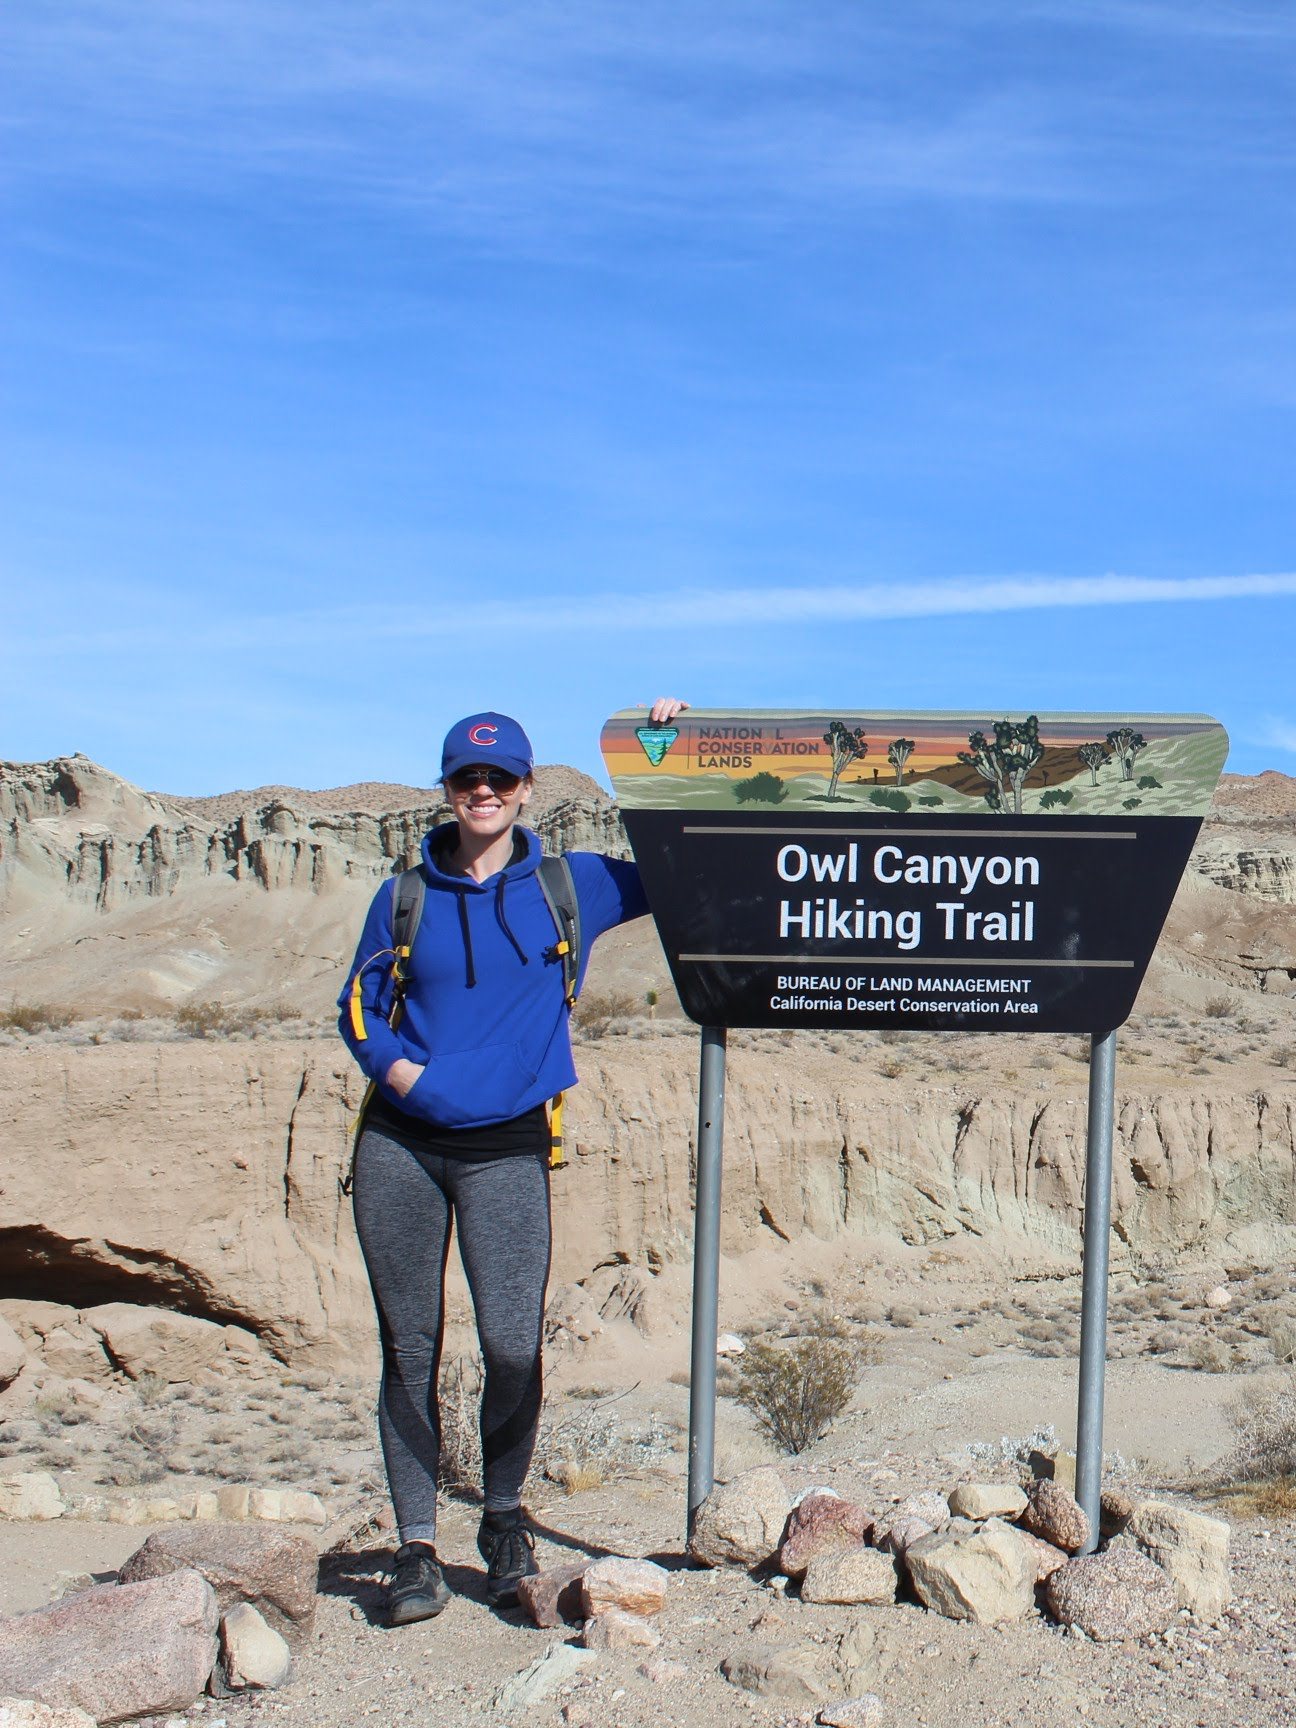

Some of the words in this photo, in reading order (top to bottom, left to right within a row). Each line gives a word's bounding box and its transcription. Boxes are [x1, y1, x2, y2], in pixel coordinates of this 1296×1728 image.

[468, 722, 498, 746] C
[699, 727, 784, 740] NATIONL
[697, 742, 819, 755] CONSERATION
[697, 755, 753, 769] LANDS
[776, 843, 858, 883] Owl
[873, 845, 1040, 895] Canyon
[779, 898, 921, 950] Hiking
[935, 900, 1034, 942] Trail
[777, 976, 841, 991] BUREAU
[845, 976, 867, 991] OF
[870, 977, 913, 992] LAND
[917, 977, 1032, 993] MANAGEMENT
[770, 995, 843, 1011] California
[846, 997, 896, 1012] Desert
[899, 997, 1000, 1013] Conservation
[1003, 999, 1039, 1014] Area
